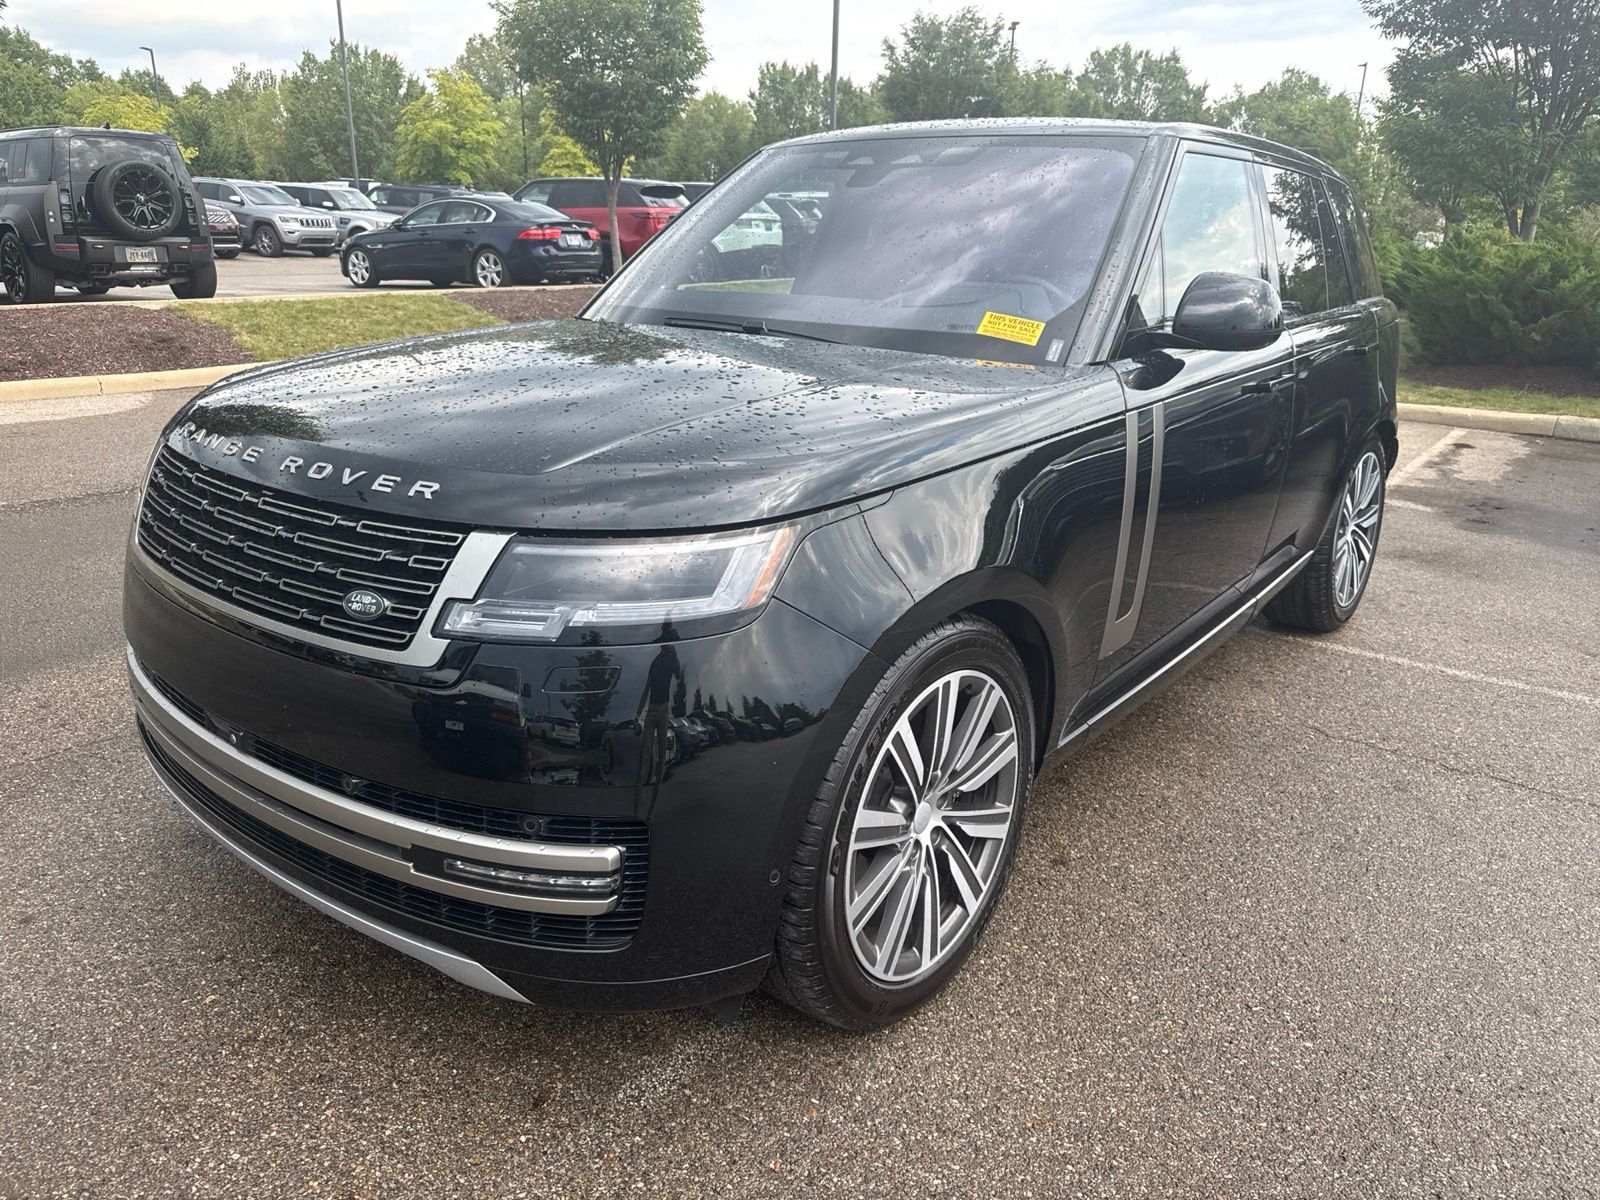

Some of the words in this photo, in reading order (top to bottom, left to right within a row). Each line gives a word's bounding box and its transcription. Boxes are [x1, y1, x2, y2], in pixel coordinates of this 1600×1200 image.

[987, 319, 1002, 327] NOT
[1003, 322, 1018, 330] FOR
[1019, 326, 1038, 334] SALE
[990, 313, 1007, 323] THIS
[1008, 317, 1042, 330] VEHICLE
[178, 421, 265, 463] RANGE
[279, 455, 441, 499] ROVER
[351, 593, 372, 604] LAND
[351, 602, 377, 613] ROVER
